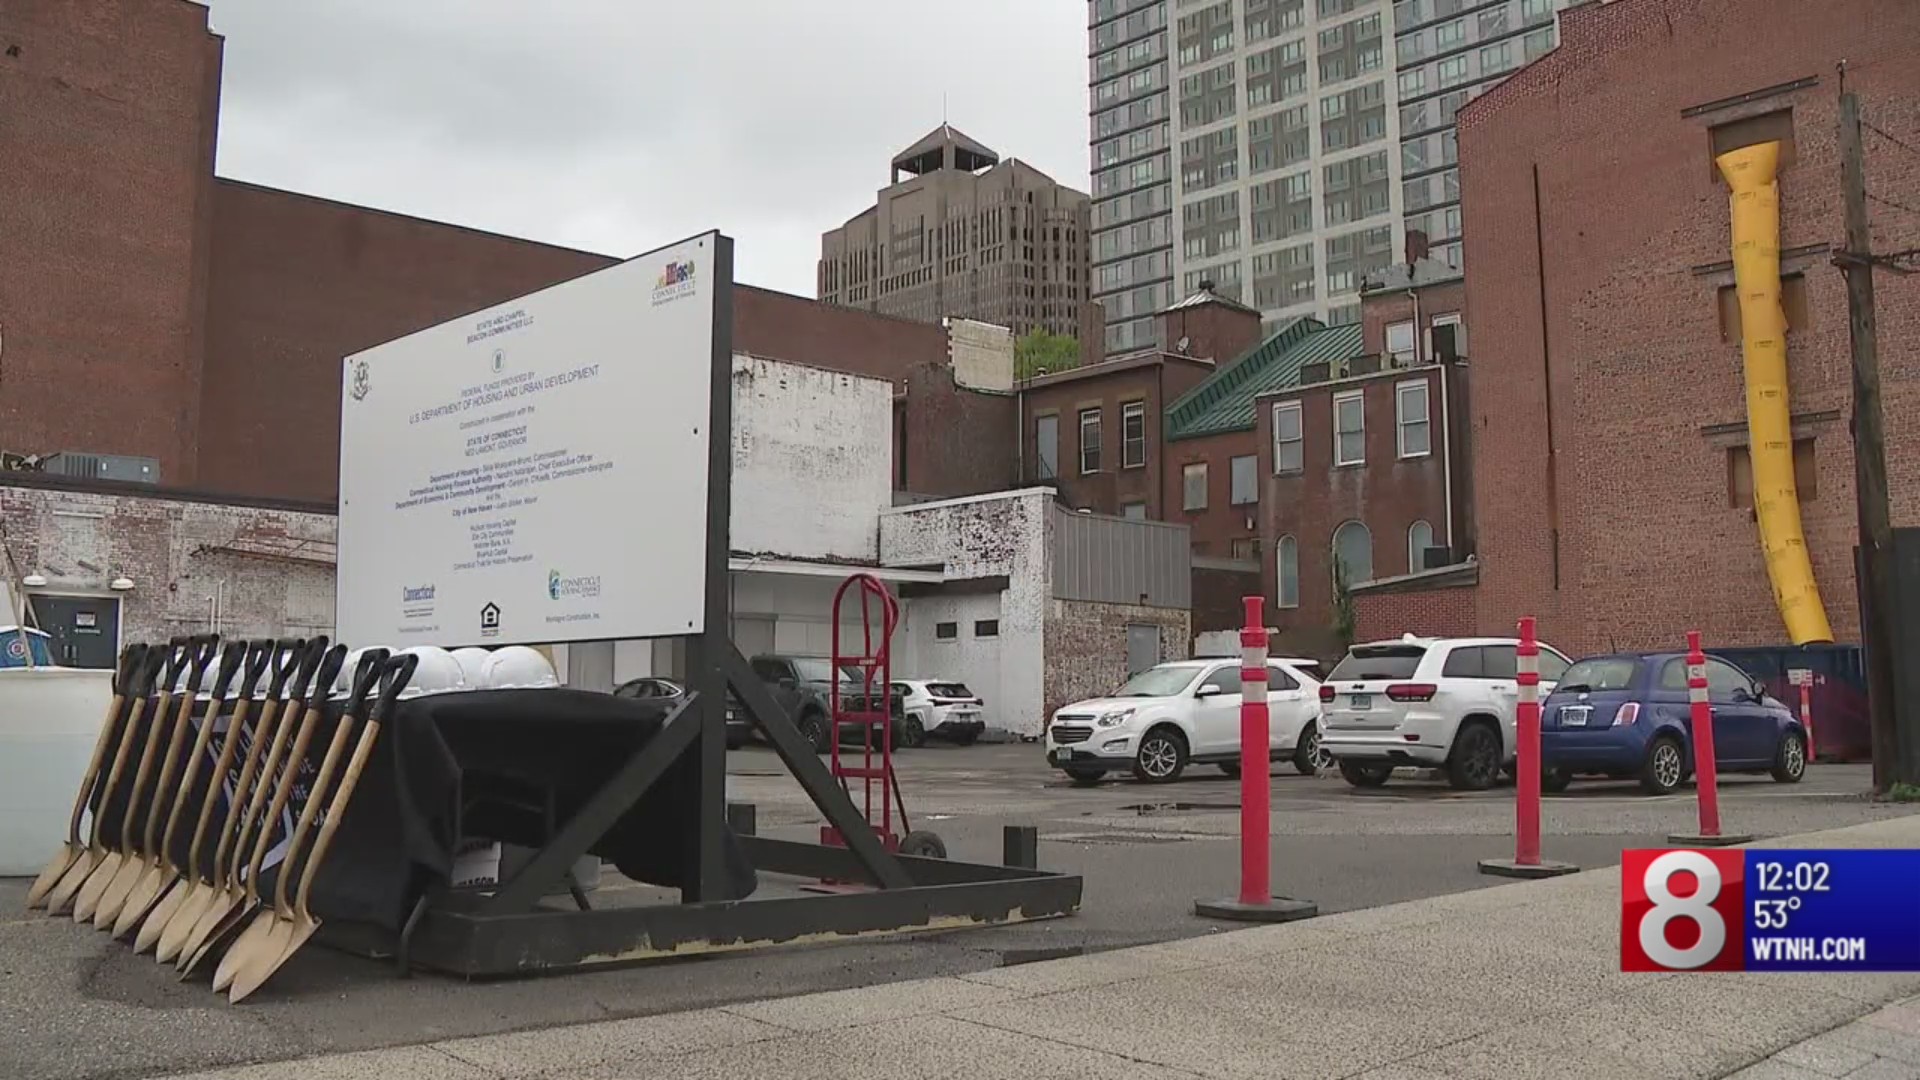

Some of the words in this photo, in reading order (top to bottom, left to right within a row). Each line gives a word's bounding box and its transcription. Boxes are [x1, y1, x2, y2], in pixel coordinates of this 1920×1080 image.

[422, 401, 461, 420] DEPARTMENT
[463, 399, 471, 410] OF
[473, 391, 502, 407] HOUSING
[504, 387, 517, 400] AND
[519, 380, 543, 396] URBAN
[544, 366, 599, 389] DEVELOPMENT
